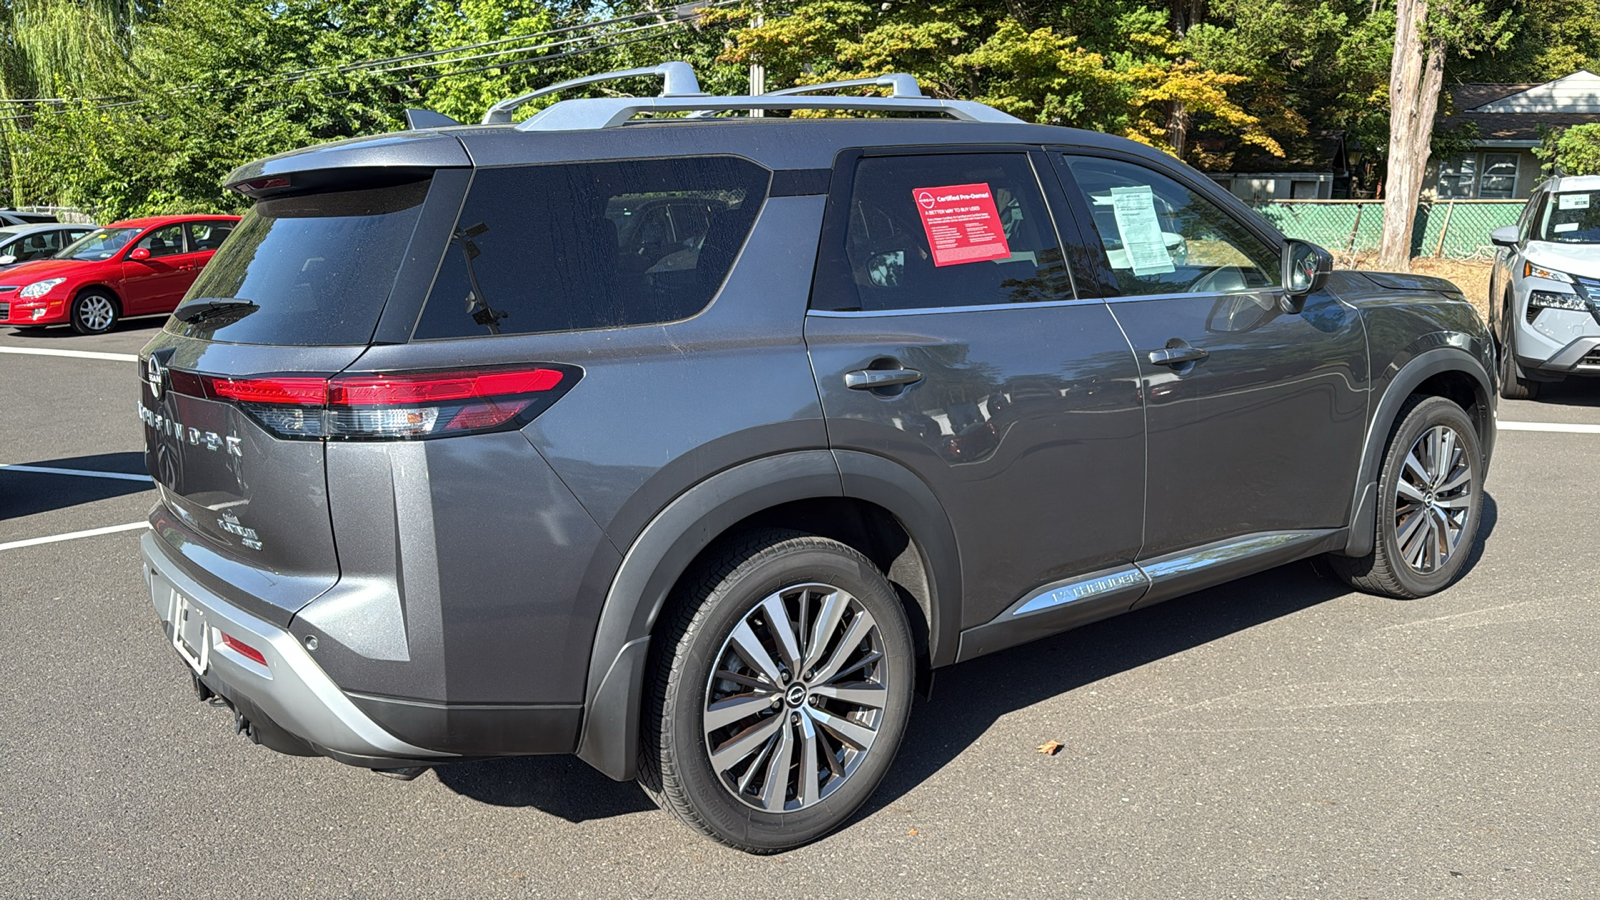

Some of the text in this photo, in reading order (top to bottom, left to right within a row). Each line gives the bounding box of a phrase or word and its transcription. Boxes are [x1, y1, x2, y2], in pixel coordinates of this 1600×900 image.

[937, 192, 989, 202] Certified Pre-Owned
[1052, 572, 1141, 603] PATHFINDER
